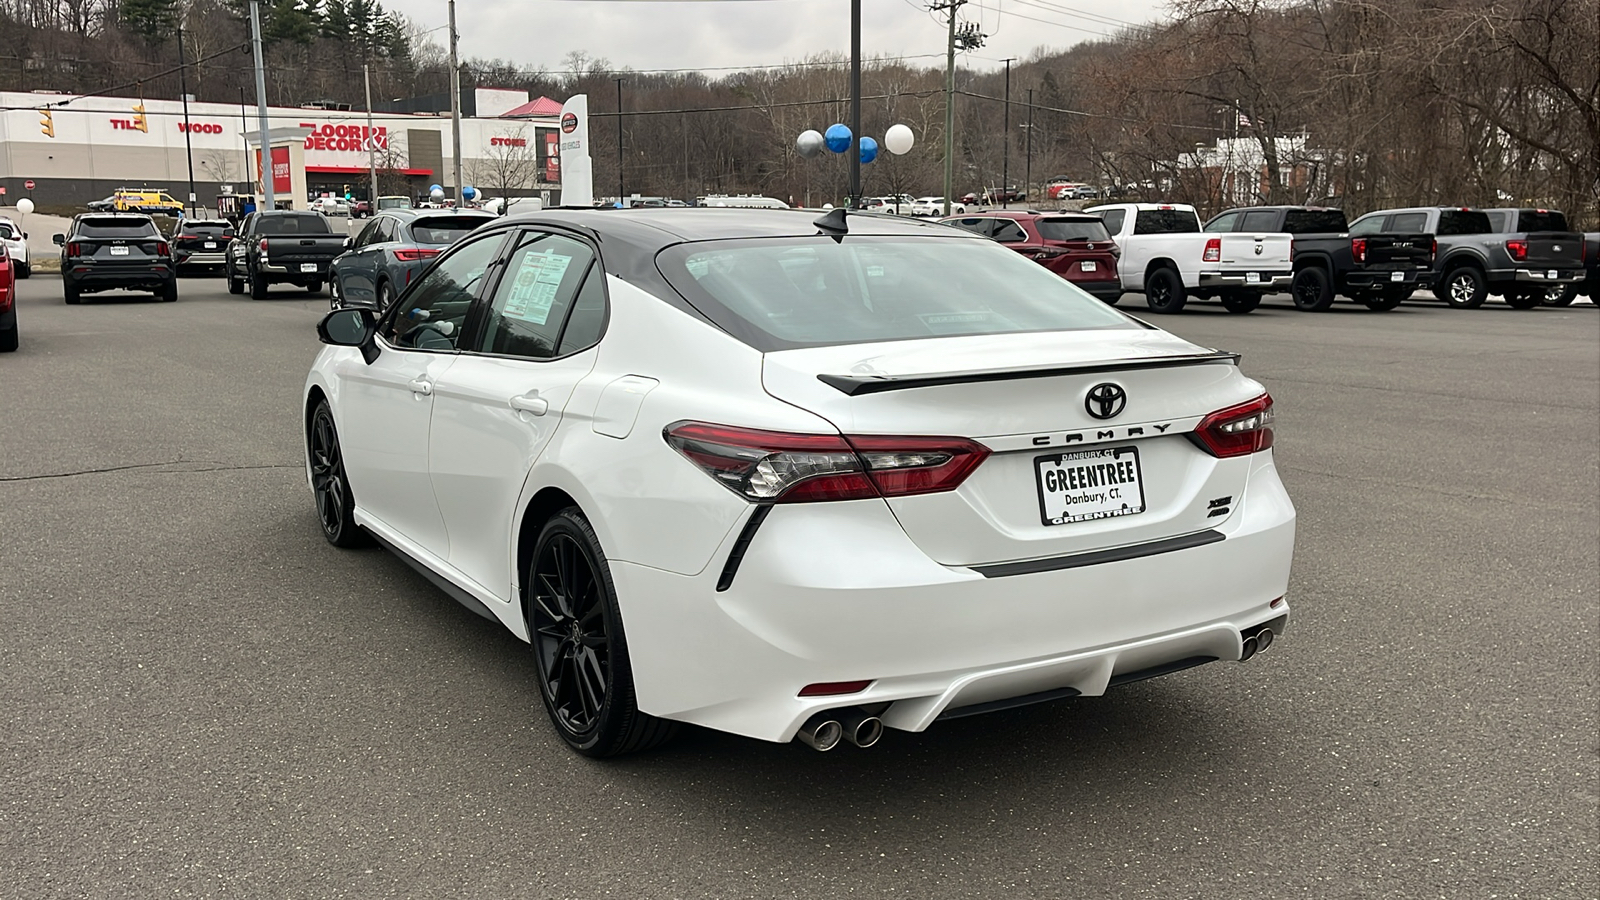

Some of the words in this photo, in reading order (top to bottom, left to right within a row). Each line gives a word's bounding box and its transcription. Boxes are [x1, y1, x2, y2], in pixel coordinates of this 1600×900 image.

[178, 122, 223, 134] WOOD
[304, 136, 362, 152] DECOR
[490, 137, 526, 147] STONE
[1032, 423, 1171, 445] CAMRY
[1104, 449, 1115, 458] CT
[1045, 461, 1135, 493] GREENTREE
[1065, 491, 1107, 506] Danbury,
[1109, 488, 1122, 500] CT.
[1051, 507, 1142, 526] GREENTREE
